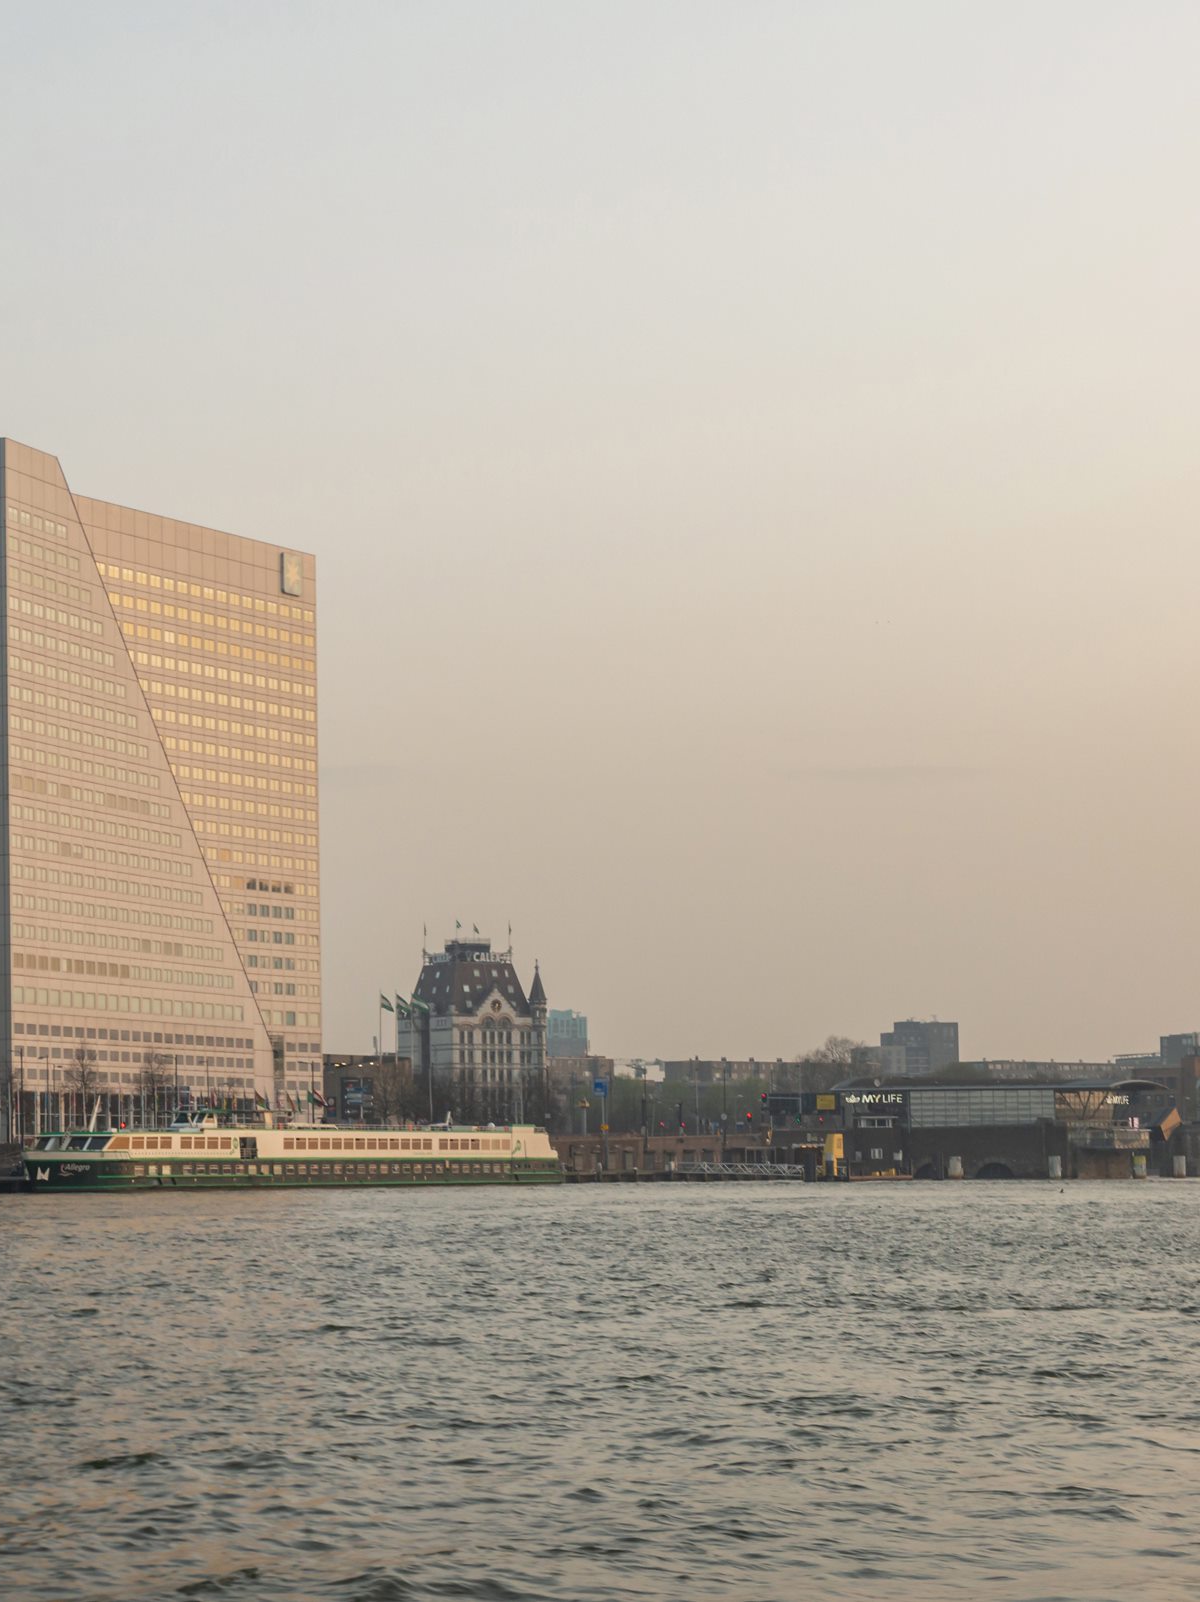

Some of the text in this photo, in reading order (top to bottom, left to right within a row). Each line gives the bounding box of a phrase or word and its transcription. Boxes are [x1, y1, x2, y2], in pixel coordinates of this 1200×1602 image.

[473, 952, 500, 962] CALEX
[862, 1094, 903, 1104] MY LIFE
